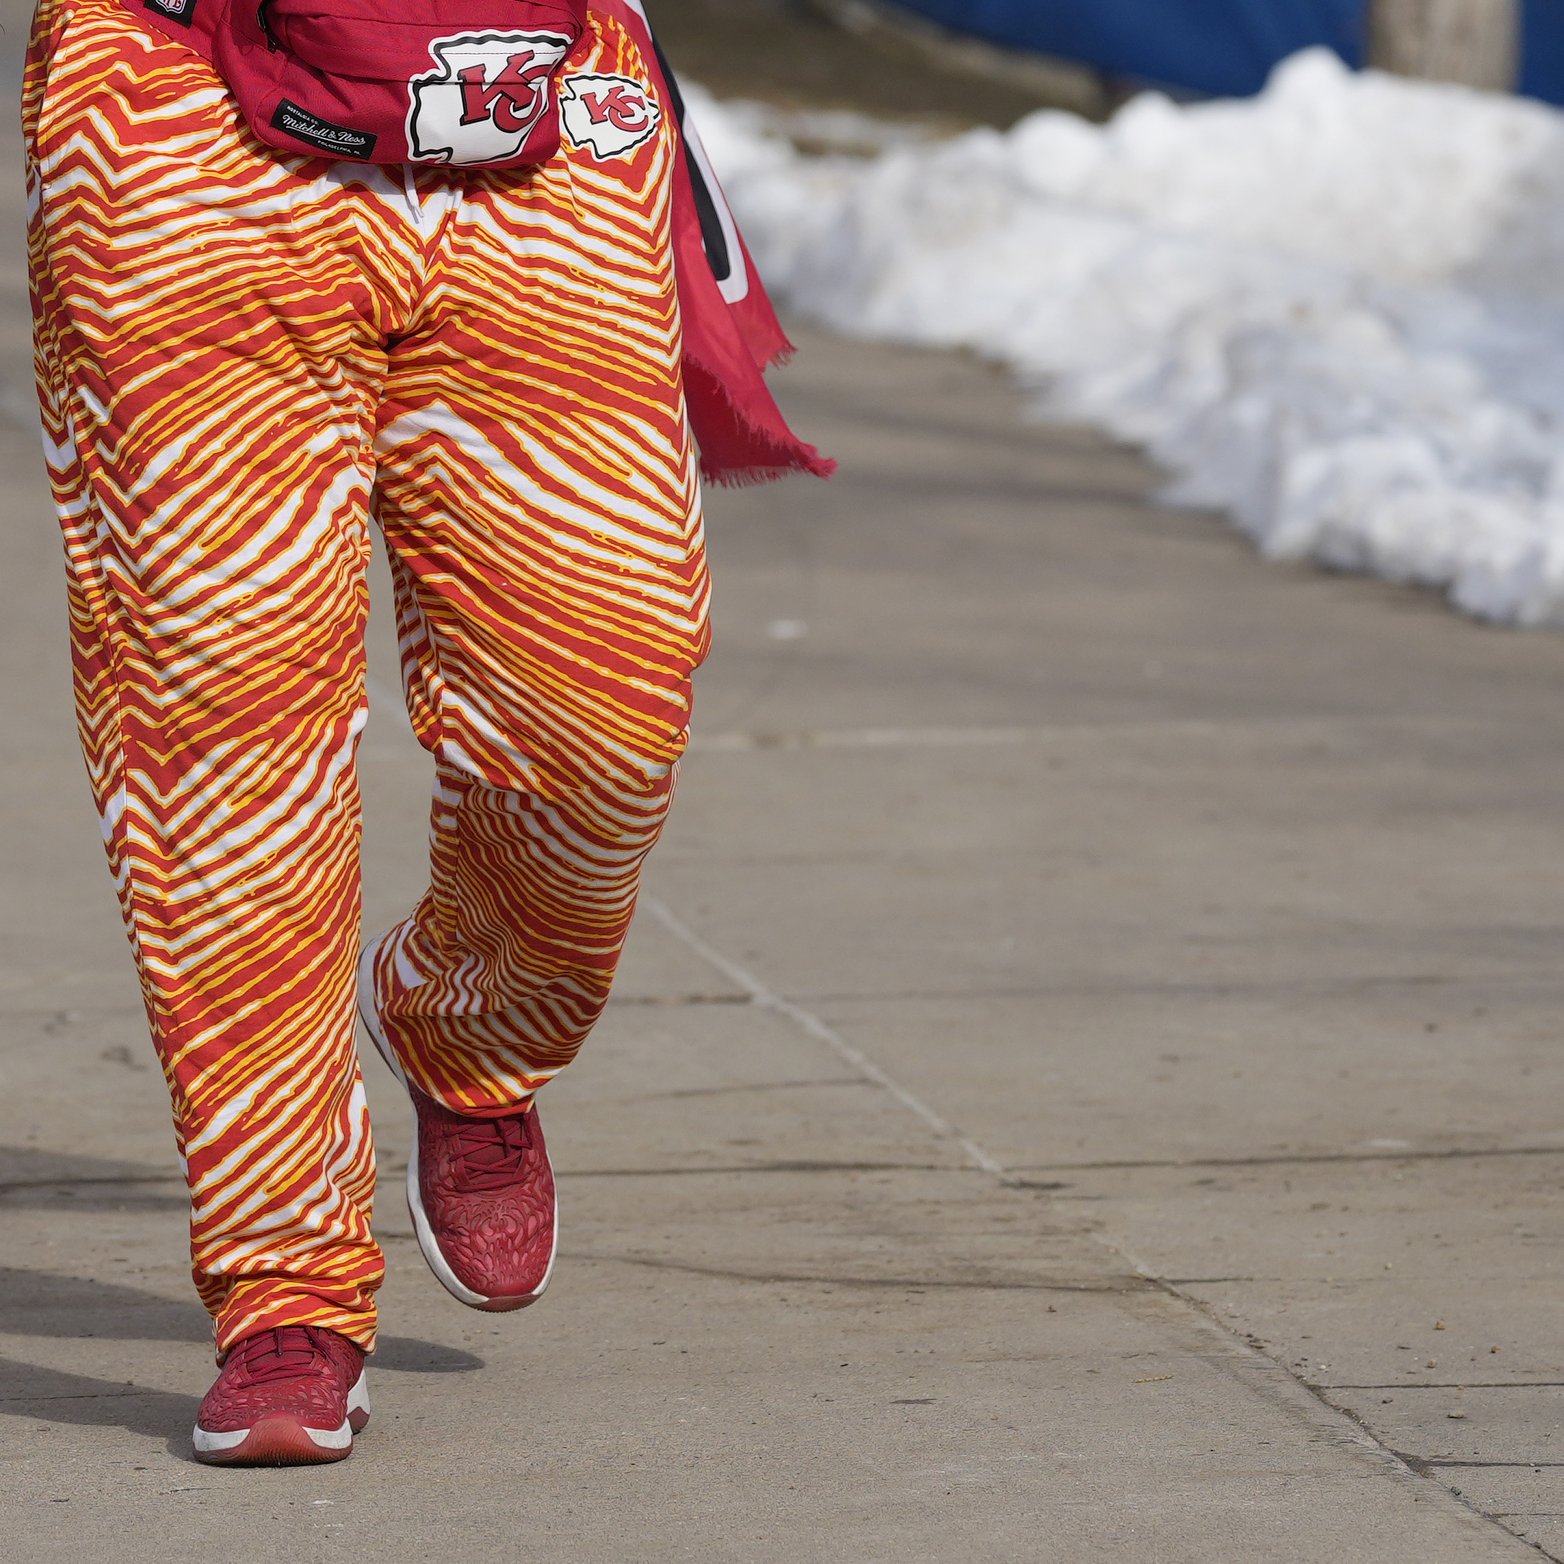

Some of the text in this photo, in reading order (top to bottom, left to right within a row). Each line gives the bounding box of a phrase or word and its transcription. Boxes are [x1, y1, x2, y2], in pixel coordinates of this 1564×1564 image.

[457, 50, 558, 134] KC
[581, 85, 649, 132] KC
[282, 114, 366, 145] Mitchell & Ness
